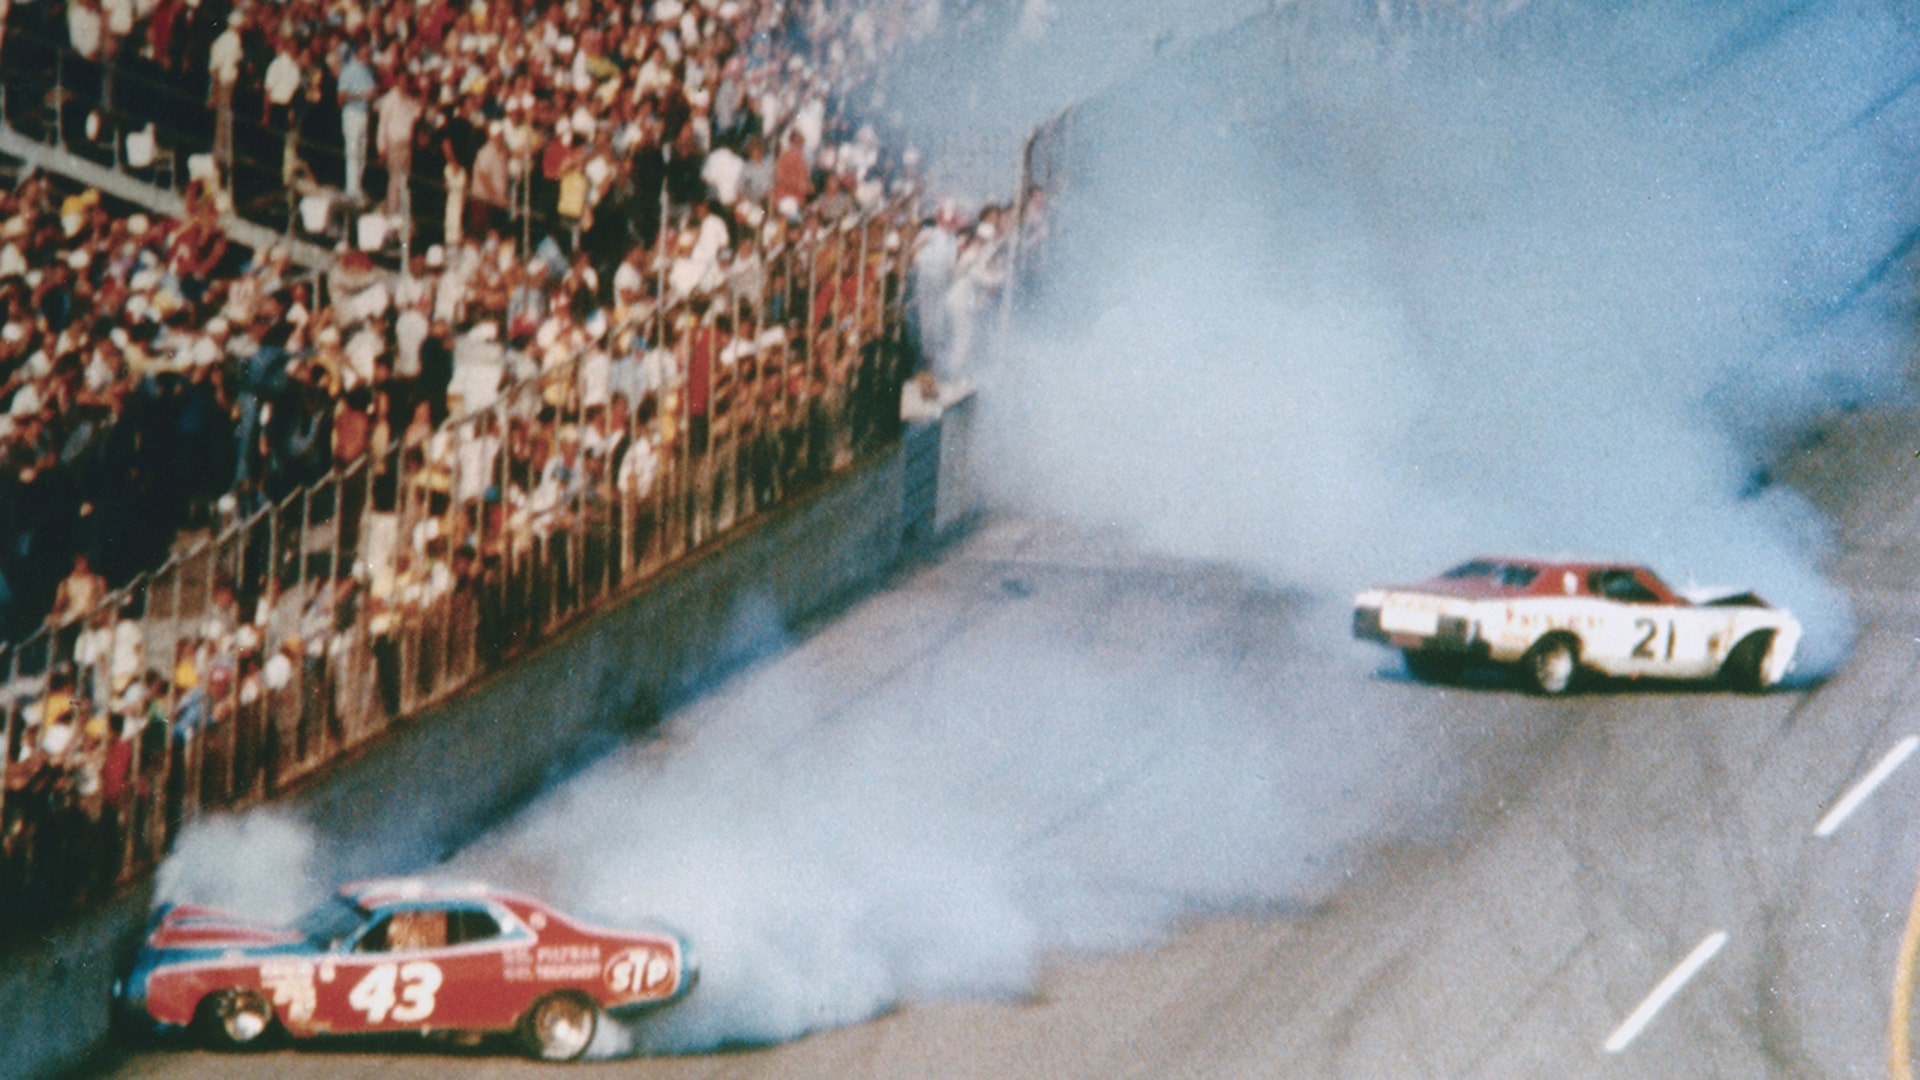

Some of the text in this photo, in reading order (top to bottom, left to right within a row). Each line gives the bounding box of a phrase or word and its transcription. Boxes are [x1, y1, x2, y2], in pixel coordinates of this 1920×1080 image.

[1632, 617, 1676, 659] 21
[349, 962, 443, 1023] 43
[612, 950, 668, 994] STP
